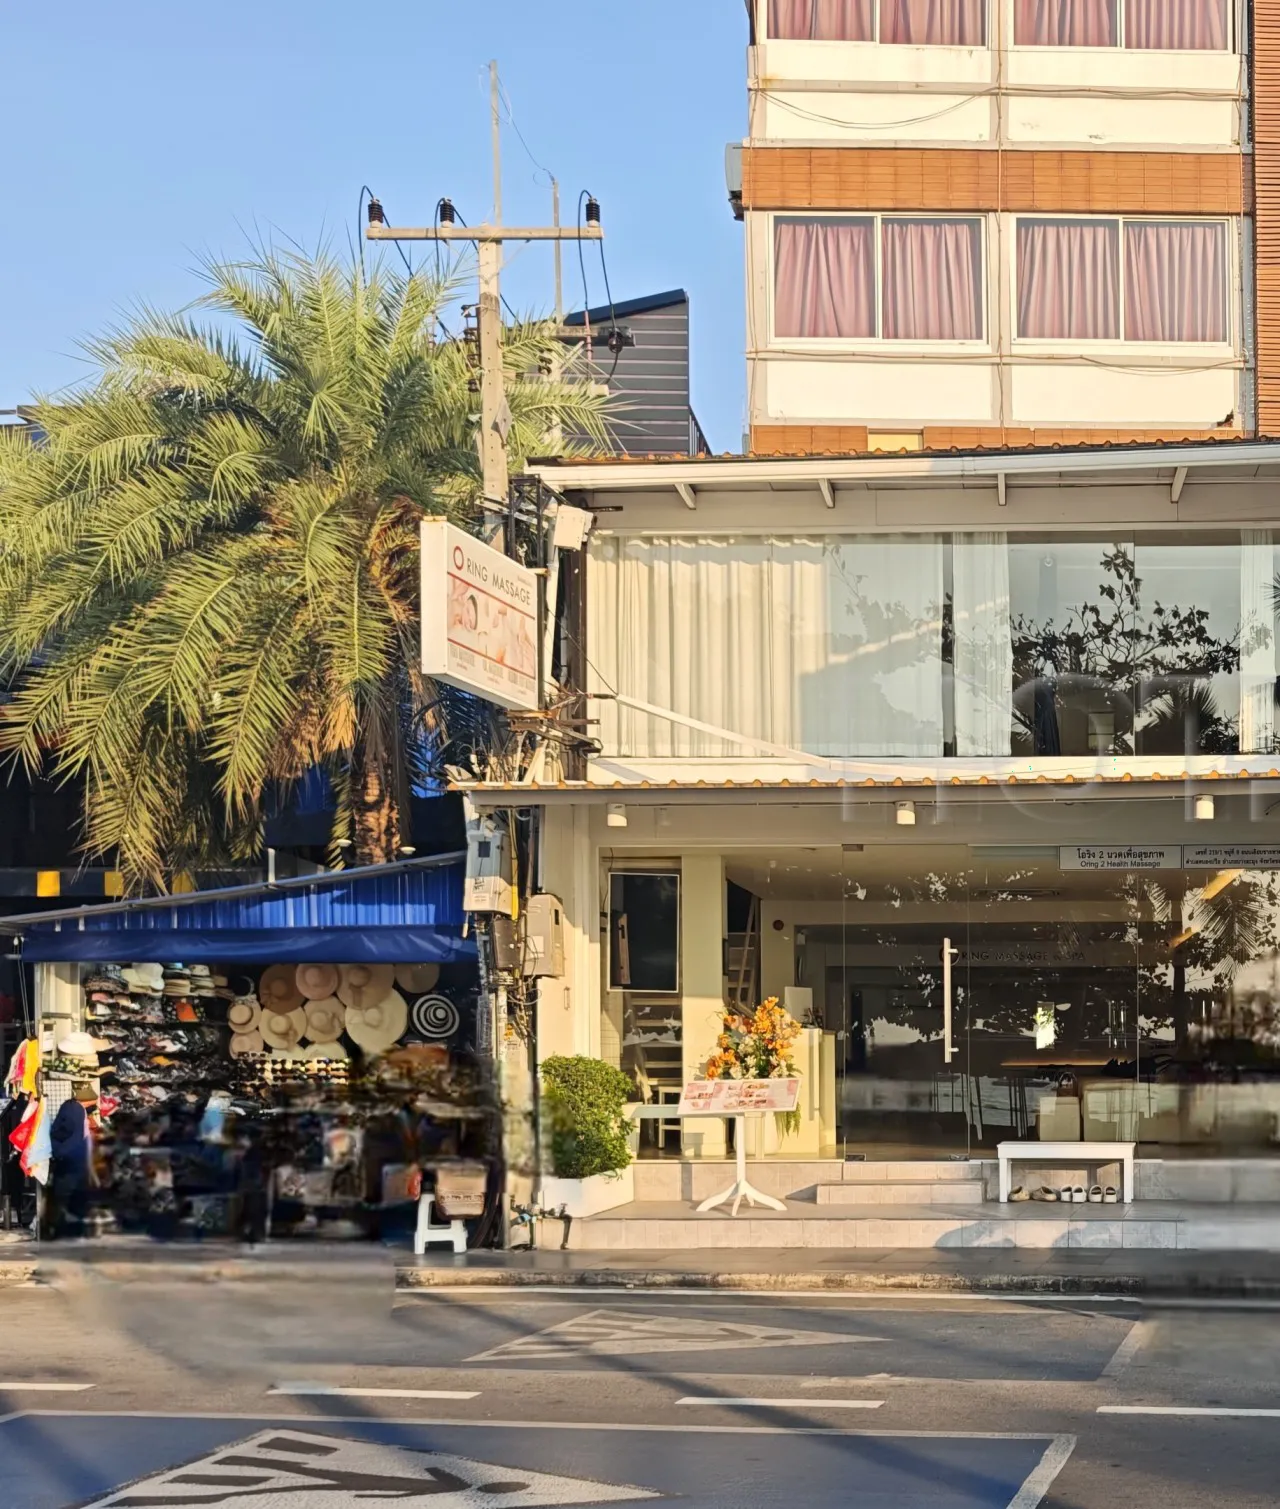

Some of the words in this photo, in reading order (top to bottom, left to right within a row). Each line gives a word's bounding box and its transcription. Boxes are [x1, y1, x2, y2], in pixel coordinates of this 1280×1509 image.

[492, 572, 531, 605] MASSAGE
[1099, 850, 1104, 859] 2
[1080, 860, 1099, 869] Oring
[1101, 860, 1106, 868] 2
[1107, 860, 1129, 868] Health
[1130, 860, 1161, 869] Massage
[995, 952, 1047, 961] MASSAGE
